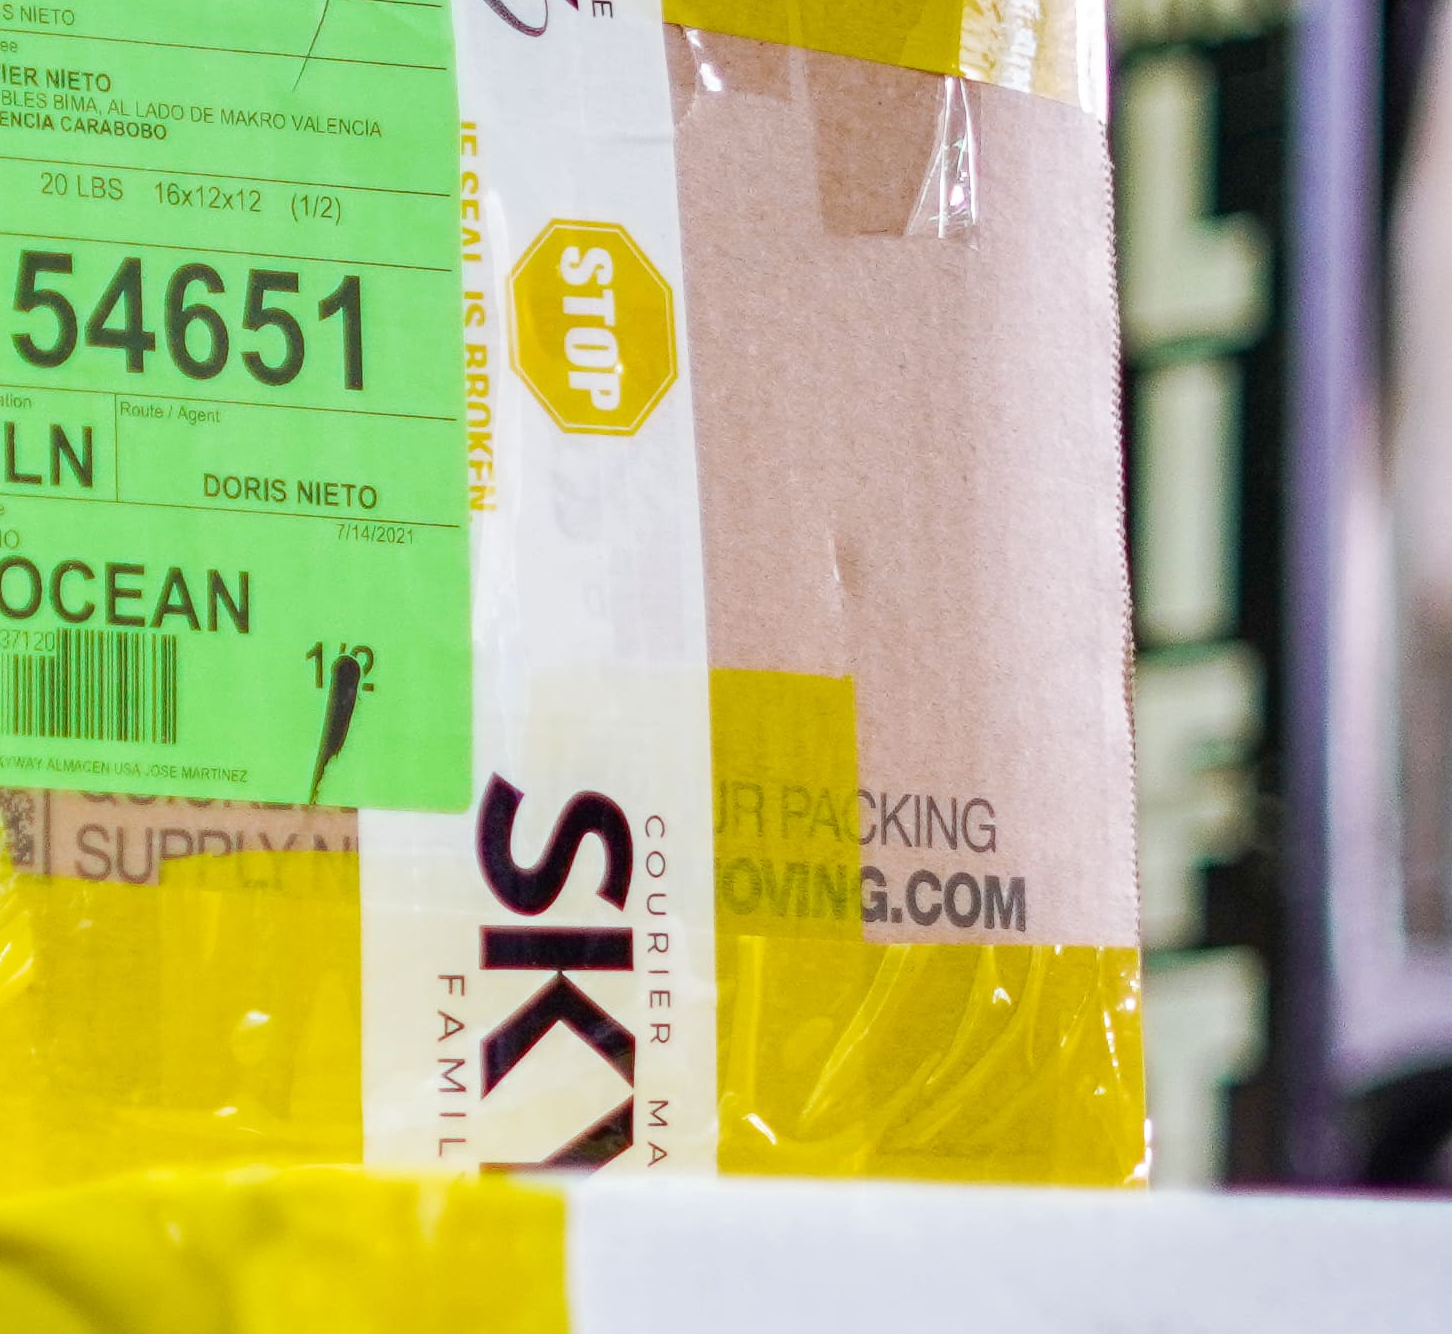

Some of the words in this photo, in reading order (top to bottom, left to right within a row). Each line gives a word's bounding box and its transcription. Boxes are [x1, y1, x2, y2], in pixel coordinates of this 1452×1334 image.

[19, 5, 76, 27] NIETO
[45, 68, 112, 93] NIETO
[54, 93, 104, 117] BIMA,
[107, 95, 130, 116] AL
[135, 98, 185, 122] LADO
[190, 102, 215, 123] DE
[219, 104, 286, 130] MAKRO
[292, 113, 383, 138] VALENCIA
[60, 114, 168, 142] CARABOBO
[40, 172, 69, 197] 20
[77, 174, 124, 202] LBS
[154, 182, 262, 213] 16x12x12
[290, 193, 343, 226] (1/2)
[9, 247, 364, 392] 54651
[559, 245, 622, 413] STOP
[119, 402, 164, 421] Route
[178, 405, 221, 426] Agent
[202, 472, 288, 503] DORIS
[297, 480, 379, 510] NIETO
[335, 523, 415, 546] 7/14/2021
[46, 757, 111, 776] ALMACEN
[114, 760, 142, 777] USA
[181, 764, 249, 784] MARTINEZ
[780, 784, 998, 854] PACKING
[716, 856, 1027, 933] OVING.COM
[644, 813, 672, 1046] COURIER
[436, 972, 470, 1177] FAMIL
